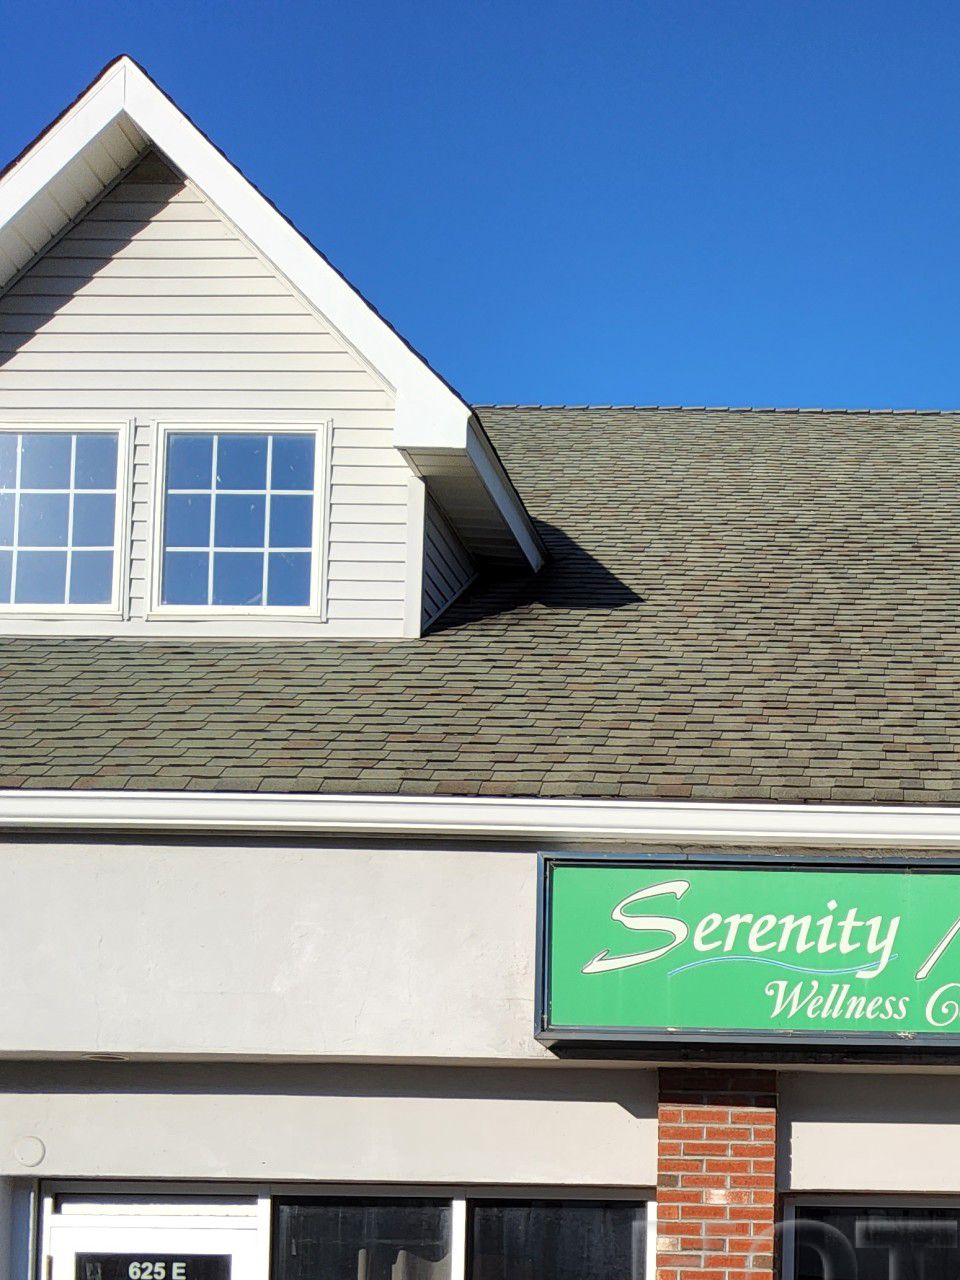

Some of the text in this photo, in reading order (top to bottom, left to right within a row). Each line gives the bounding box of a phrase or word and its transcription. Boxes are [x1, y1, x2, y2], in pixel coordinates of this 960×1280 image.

[581, 880, 900, 979] Serenity
[765, 980, 910, 1019] Wellness
[128, 1261, 187, 1280] 625 E
